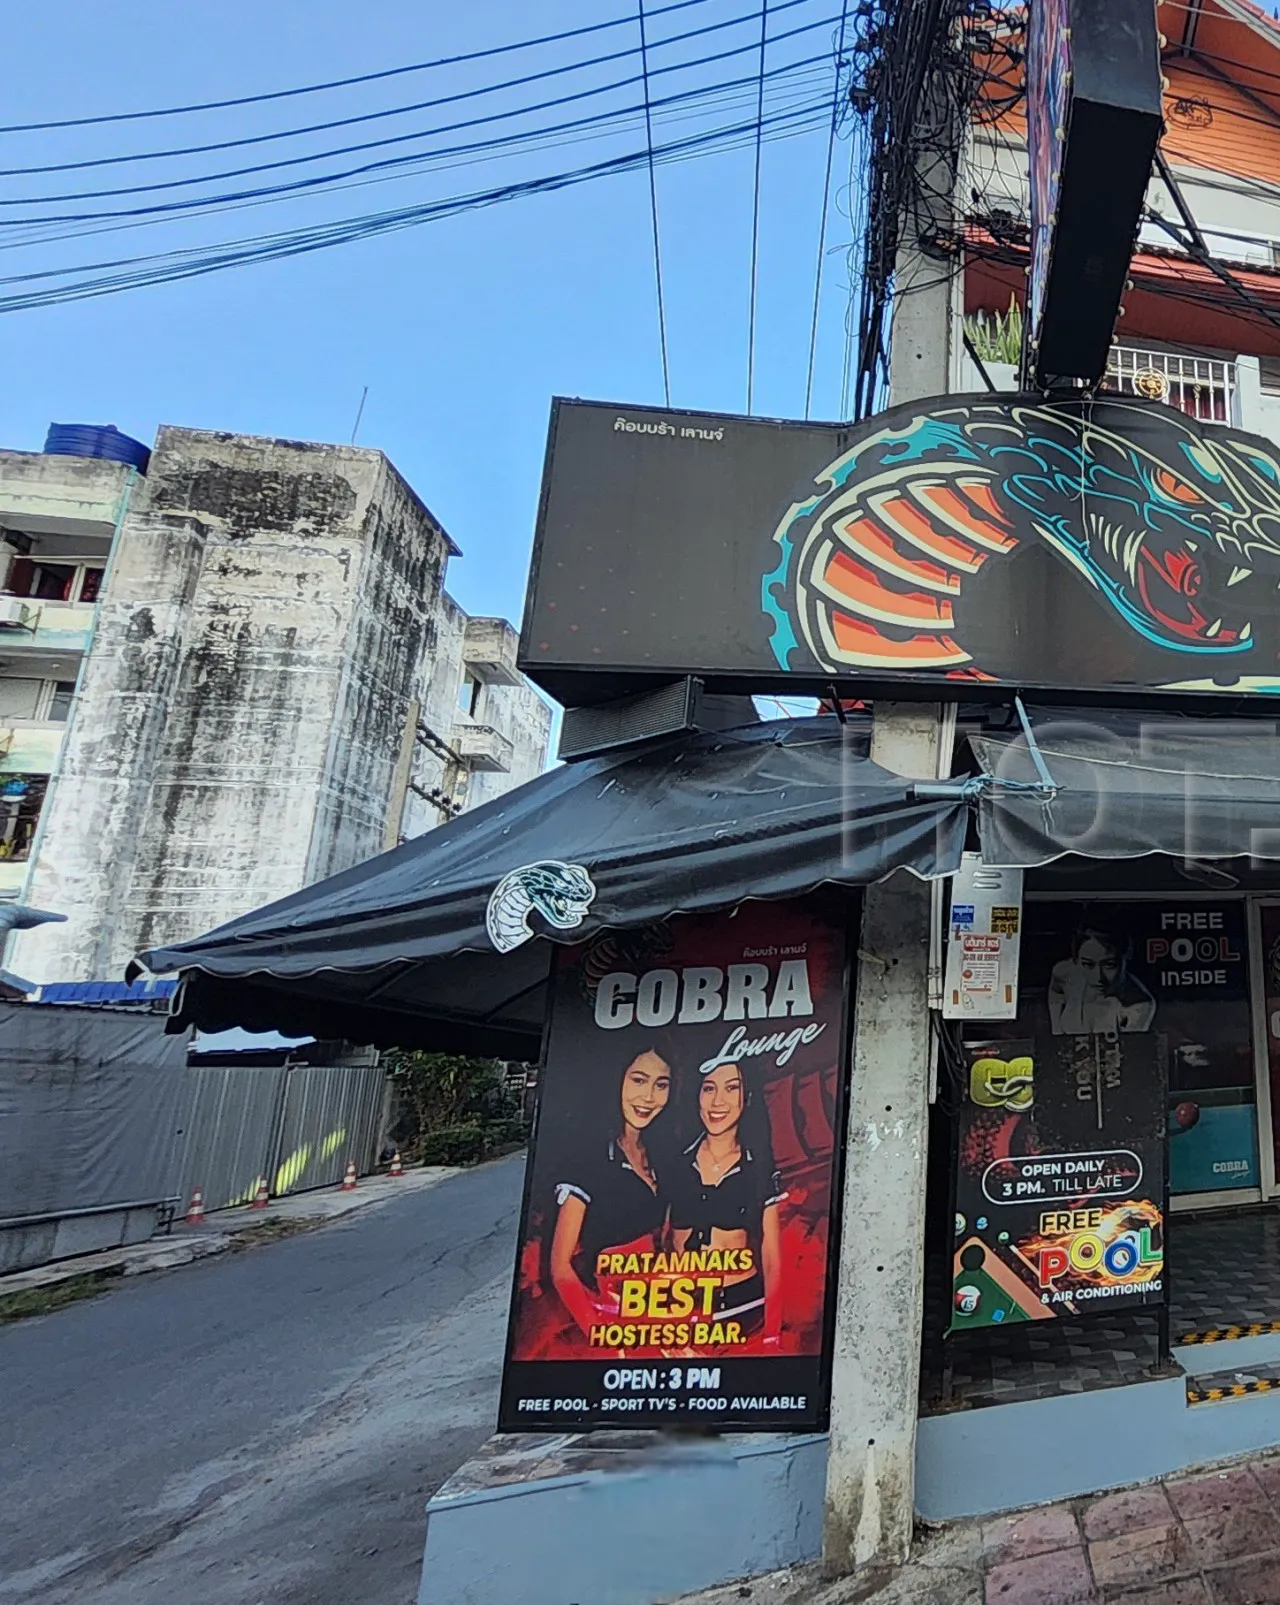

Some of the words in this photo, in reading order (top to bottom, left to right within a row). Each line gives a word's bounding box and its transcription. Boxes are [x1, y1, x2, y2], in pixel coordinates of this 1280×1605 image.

[1161, 912, 1224, 930] FREE
[1146, 936, 1241, 963] POOL
[594, 958, 814, 1030] COBRA
[699, 1022, 828, 1074] Lounge
[1022, 1163, 1061, 1177] OPEN
[1065, 1159, 1105, 1174] DAILY
[1002, 1183, 1013, 1196] 3
[1016, 1180, 1046, 1196] PM.
[1052, 1178, 1083, 1192] TILL
[1087, 1174, 1123, 1189] LATE
[1040, 1209, 1102, 1234] FREE
[596, 1249, 753, 1275] PRATAMNAKS
[1039, 1226, 1164, 1288] POOL
[621, 1277, 723, 1319] BEST
[1041, 1291, 1050, 1304] &
[1052, 1290, 1073, 1302] AIR
[1075, 1280, 1163, 1300] CONDITIONING
[589, 1323, 690, 1347] HOSTESS
[694, 1322, 747, 1345] BAR.
[669, 1369, 682, 1388] 3
[686, 1367, 721, 1389] PM
[518, 1399, 551, 1412] FREE
[554, 1399, 590, 1411] POOL
[601, 1399, 645, 1411] SPORT
[649, 1398, 677, 1410] TV'S
[688, 1398, 727, 1410] FOOD
[730, 1396, 807, 1410] AVAILABLE
